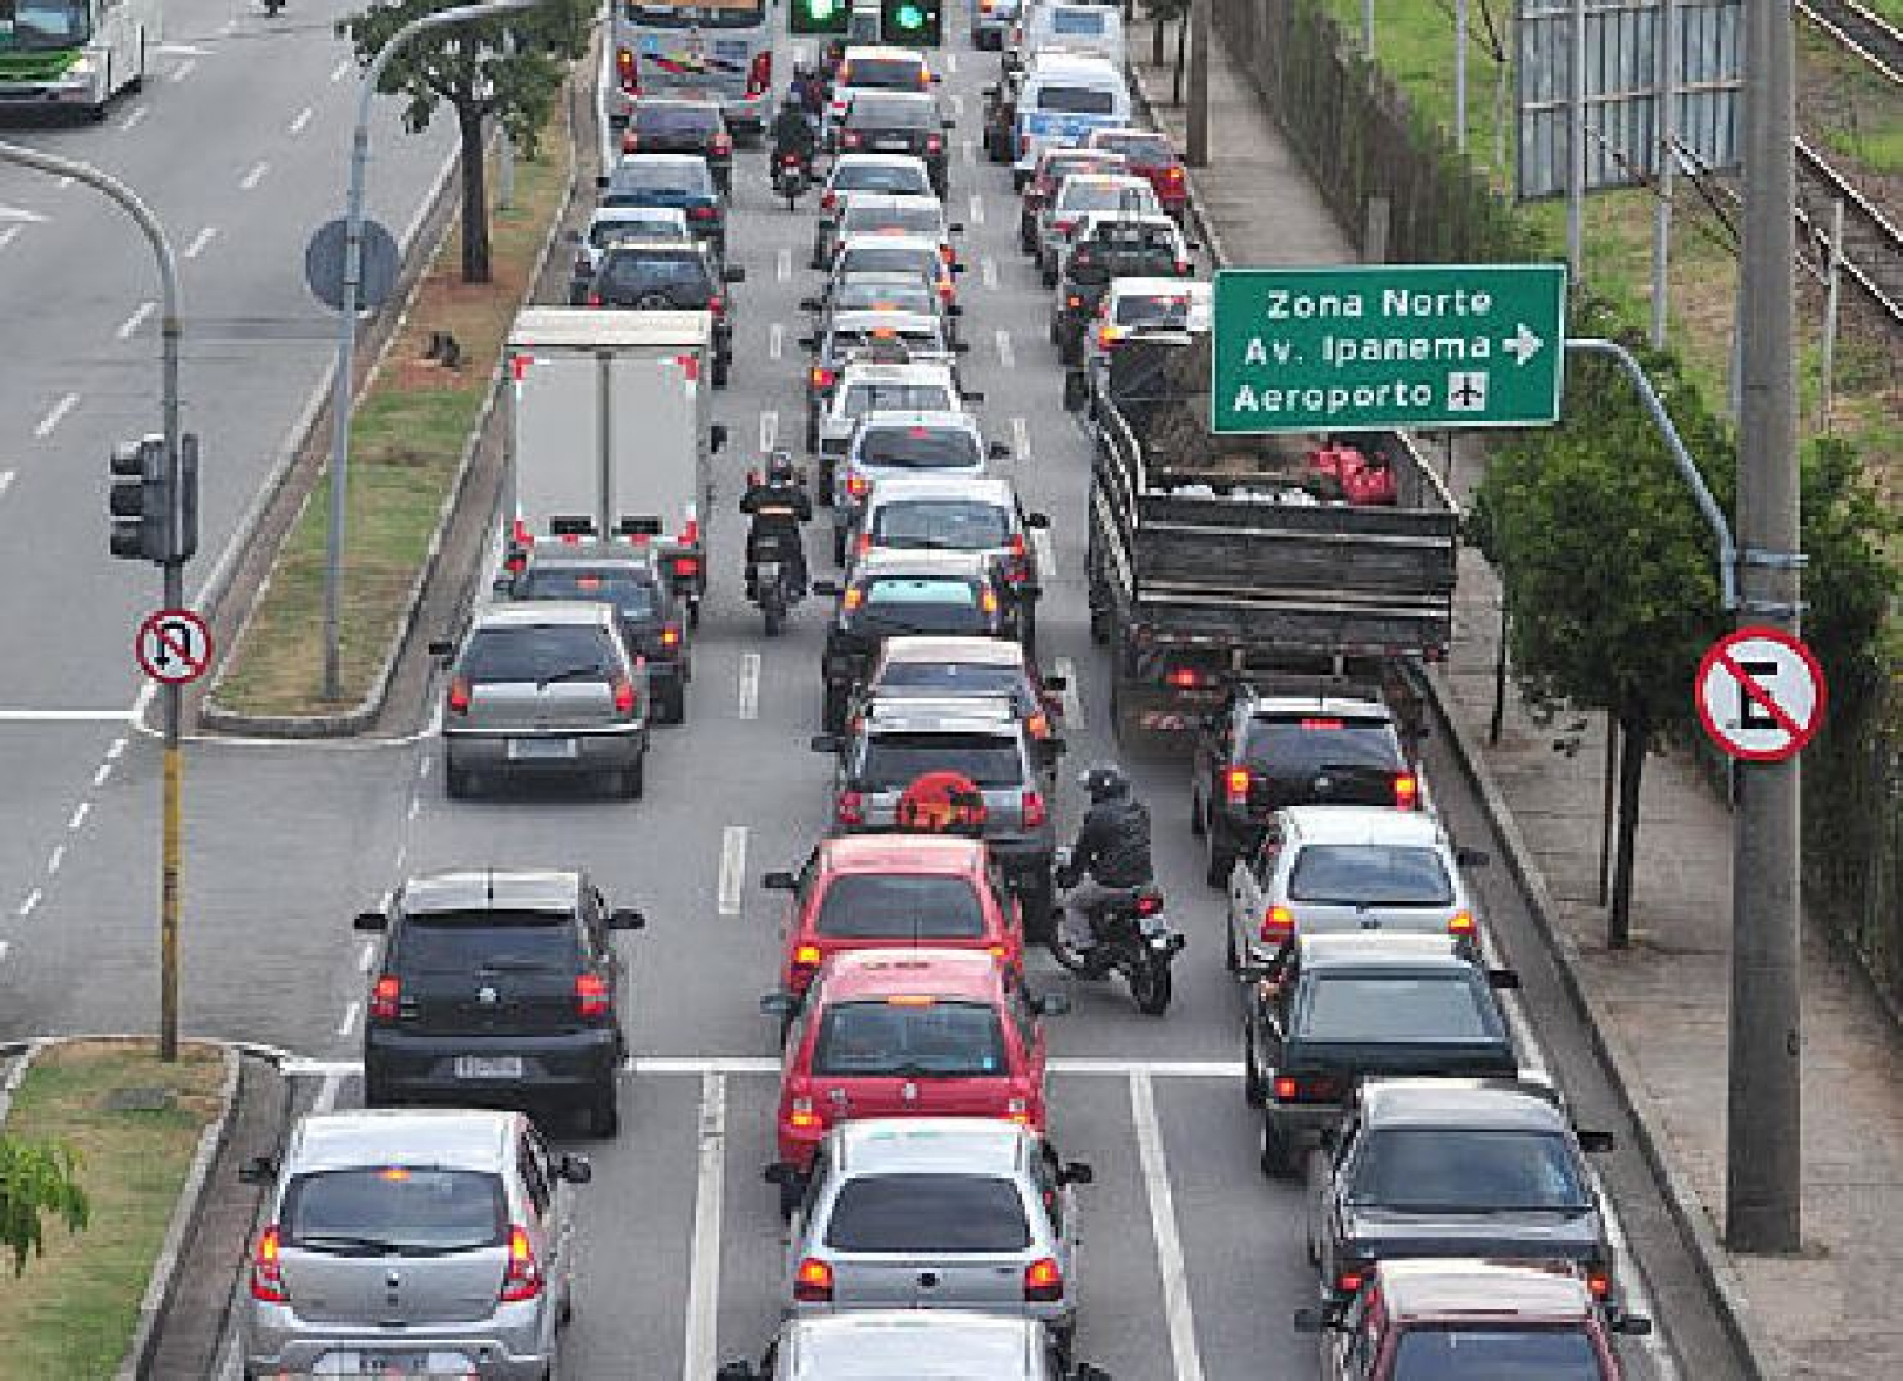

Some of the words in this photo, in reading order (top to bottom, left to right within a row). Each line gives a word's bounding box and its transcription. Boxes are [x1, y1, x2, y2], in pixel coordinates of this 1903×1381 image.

[1267, 289, 1363, 319] Zona
[1383, 288, 1493, 317] Norte
[1245, 337, 1303, 365] Av.
[1321, 335, 1491, 368] Ipanema
[1233, 380, 1432, 414] Aeroporto
[1736, 661, 1778, 730] E
